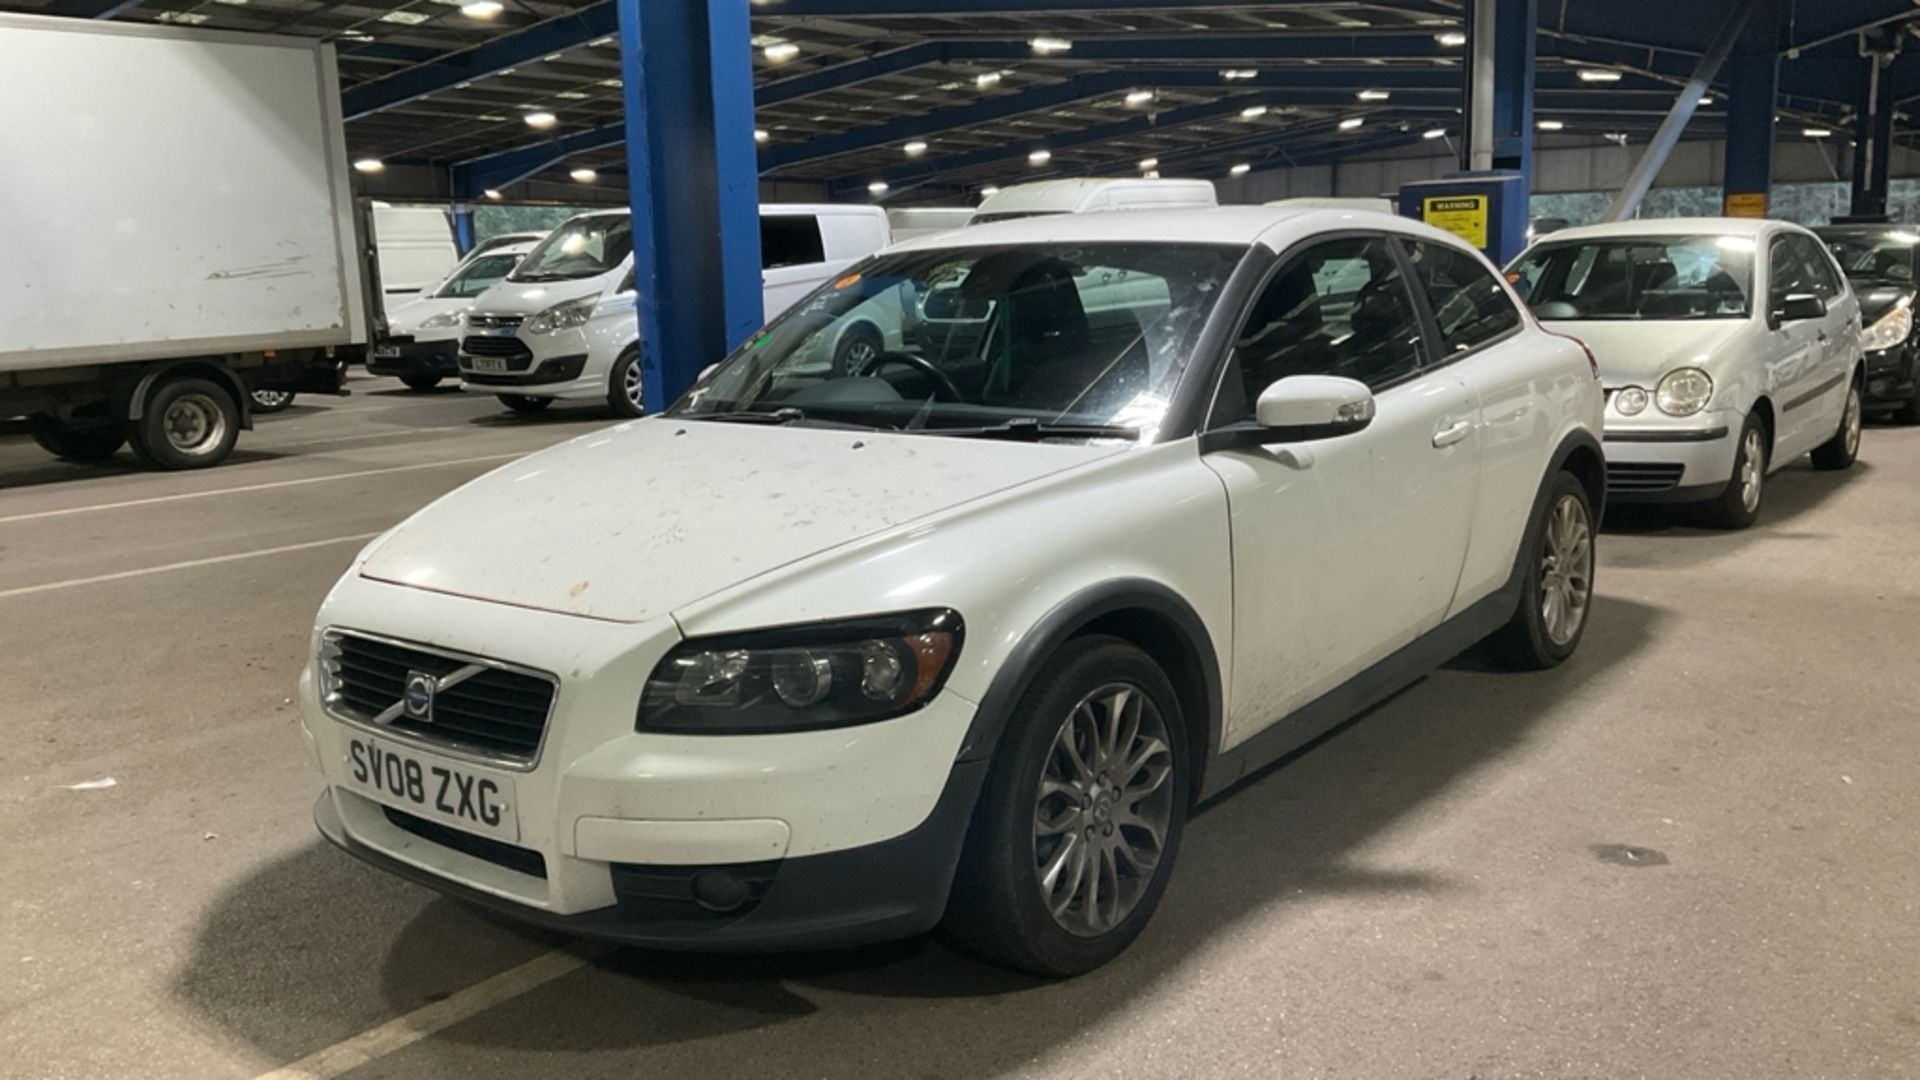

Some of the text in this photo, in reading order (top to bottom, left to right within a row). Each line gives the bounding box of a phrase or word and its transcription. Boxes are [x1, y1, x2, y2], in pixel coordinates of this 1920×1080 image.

[1436, 200, 1476, 210] WARNING
[350, 739, 501, 827] SV08 ZXG
